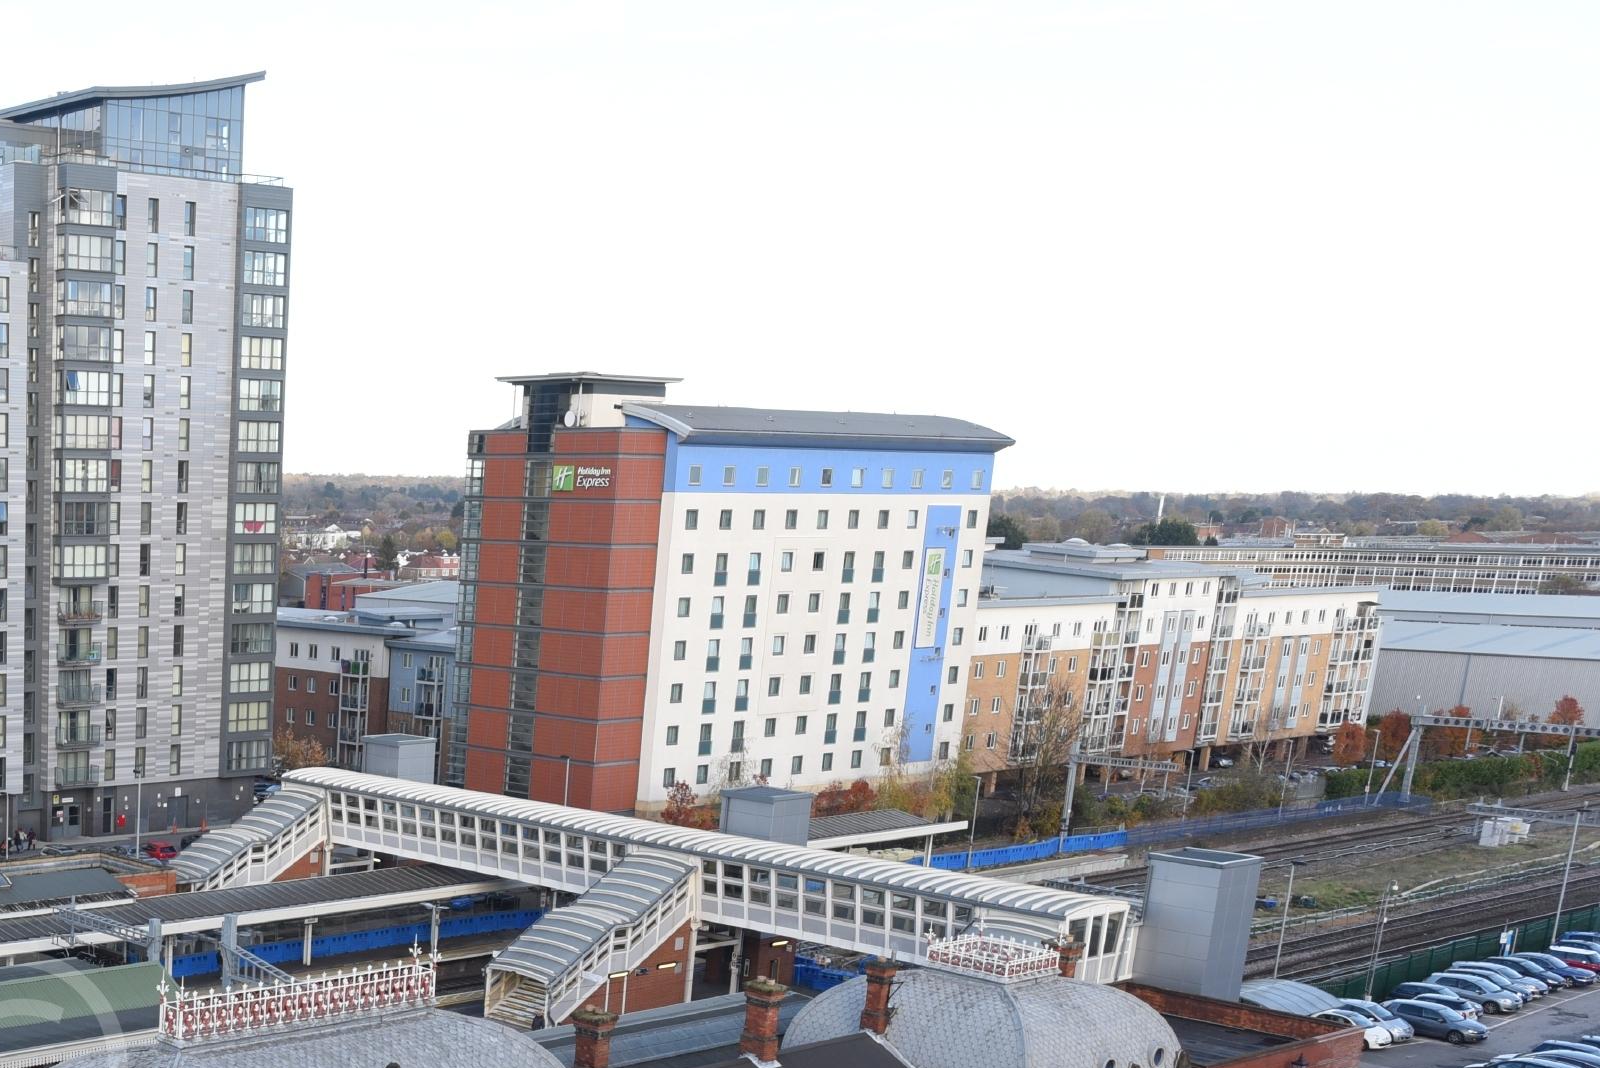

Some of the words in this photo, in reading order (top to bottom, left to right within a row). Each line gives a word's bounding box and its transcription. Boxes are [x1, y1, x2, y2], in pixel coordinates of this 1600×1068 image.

[577, 466, 600, 476] Holiday
[601, 466, 611, 475] Inn
[576, 476, 610, 491] Express
[927, 579, 940, 620] Holiday
[926, 622, 934, 637] Inn
